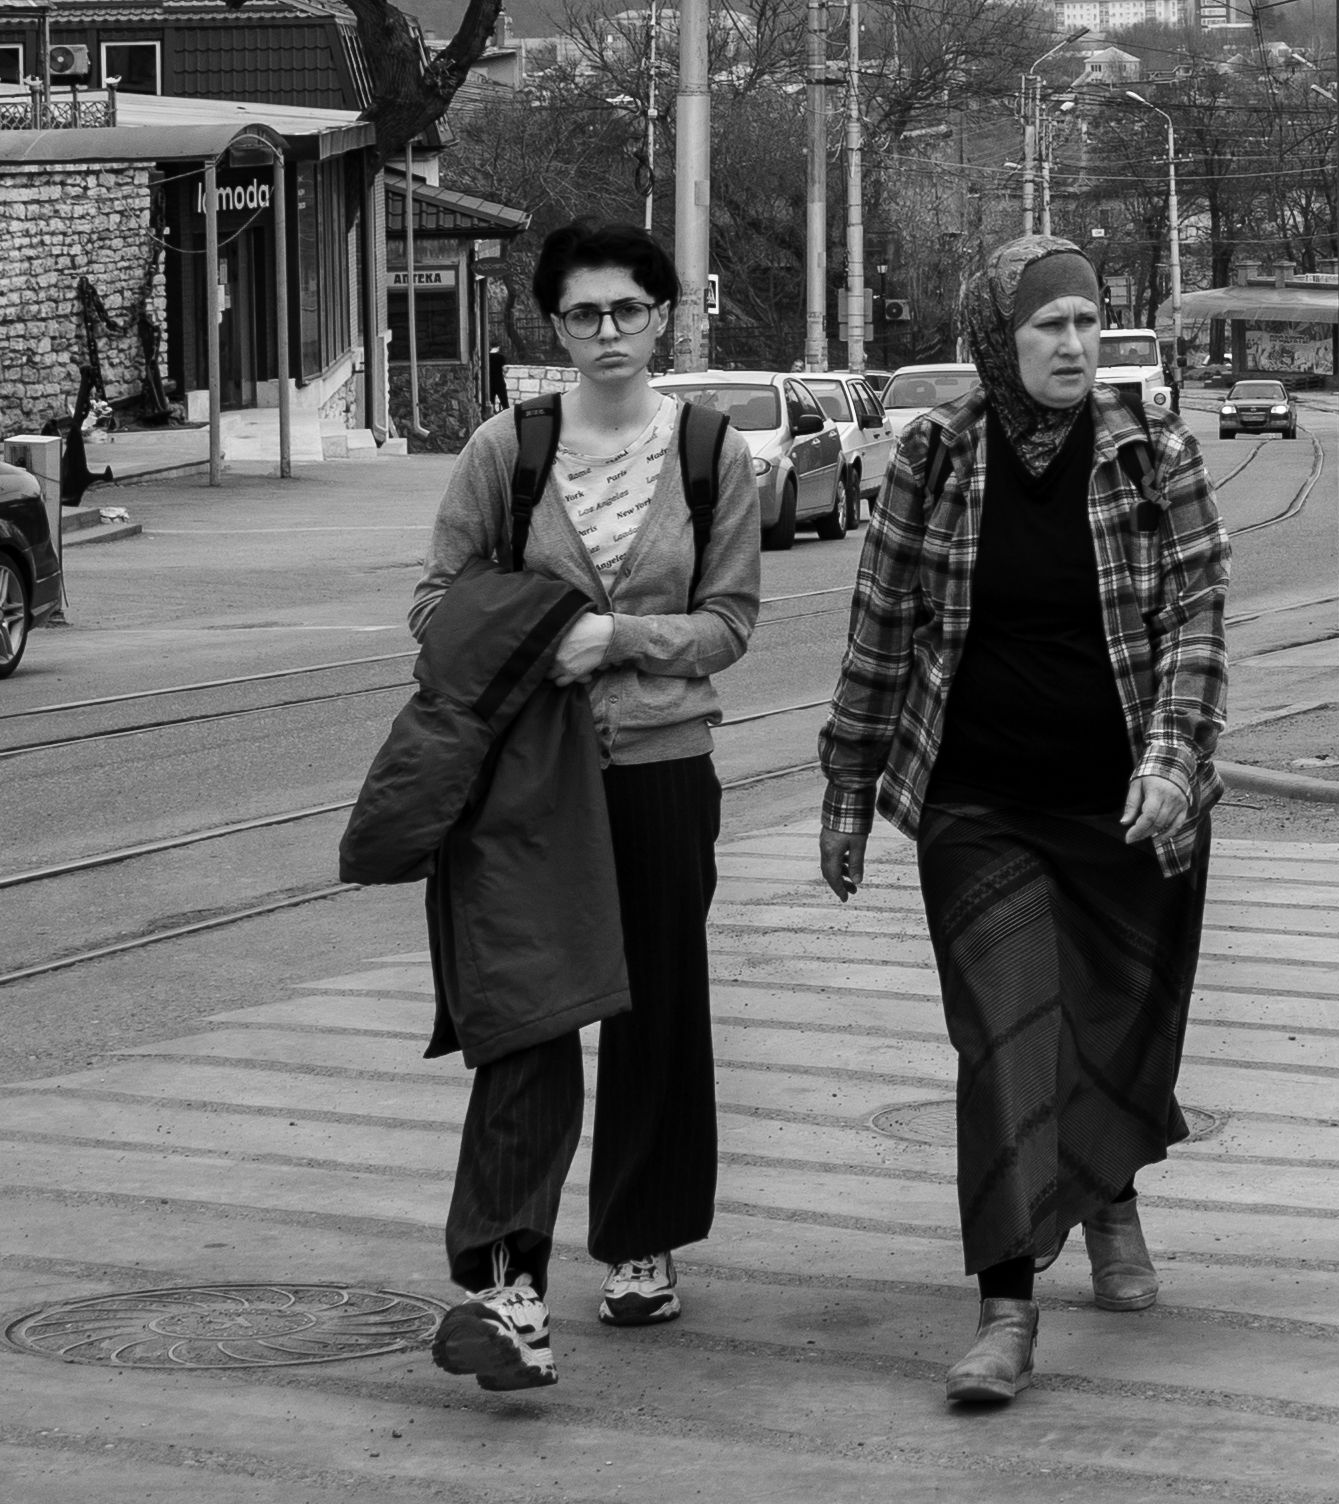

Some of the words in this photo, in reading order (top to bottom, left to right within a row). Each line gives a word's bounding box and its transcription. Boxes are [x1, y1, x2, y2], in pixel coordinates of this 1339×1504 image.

[198, 178, 270, 214] lmoda
[606, 470, 627, 484] Paris
[564, 491, 585, 502] York
[596, 490, 629, 510] Angeles
[616, 506, 636, 520] New
